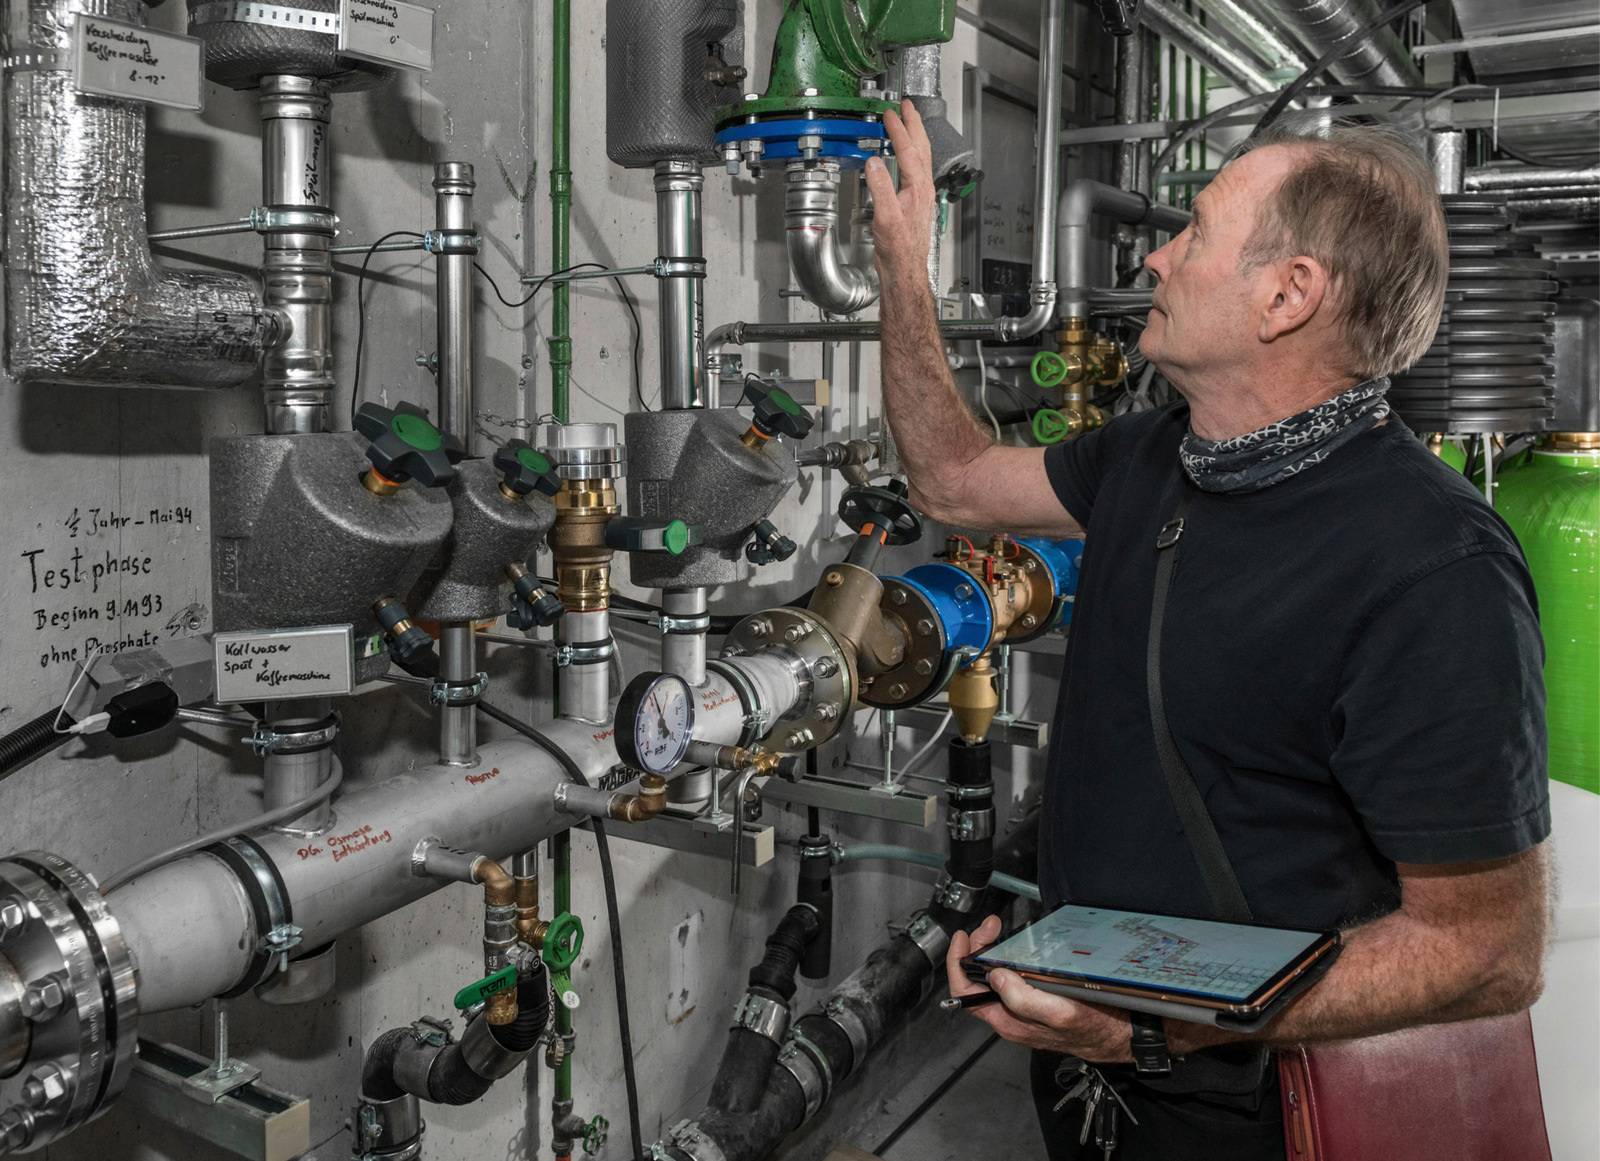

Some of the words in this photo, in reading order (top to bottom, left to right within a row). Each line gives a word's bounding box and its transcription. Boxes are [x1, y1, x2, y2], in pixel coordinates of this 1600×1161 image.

[86, 508, 131, 536] Jahr
[33, 606, 99, 631] Beginn
[39, 644, 78, 668] ohne
[327, 824, 373, 847] Osmose
